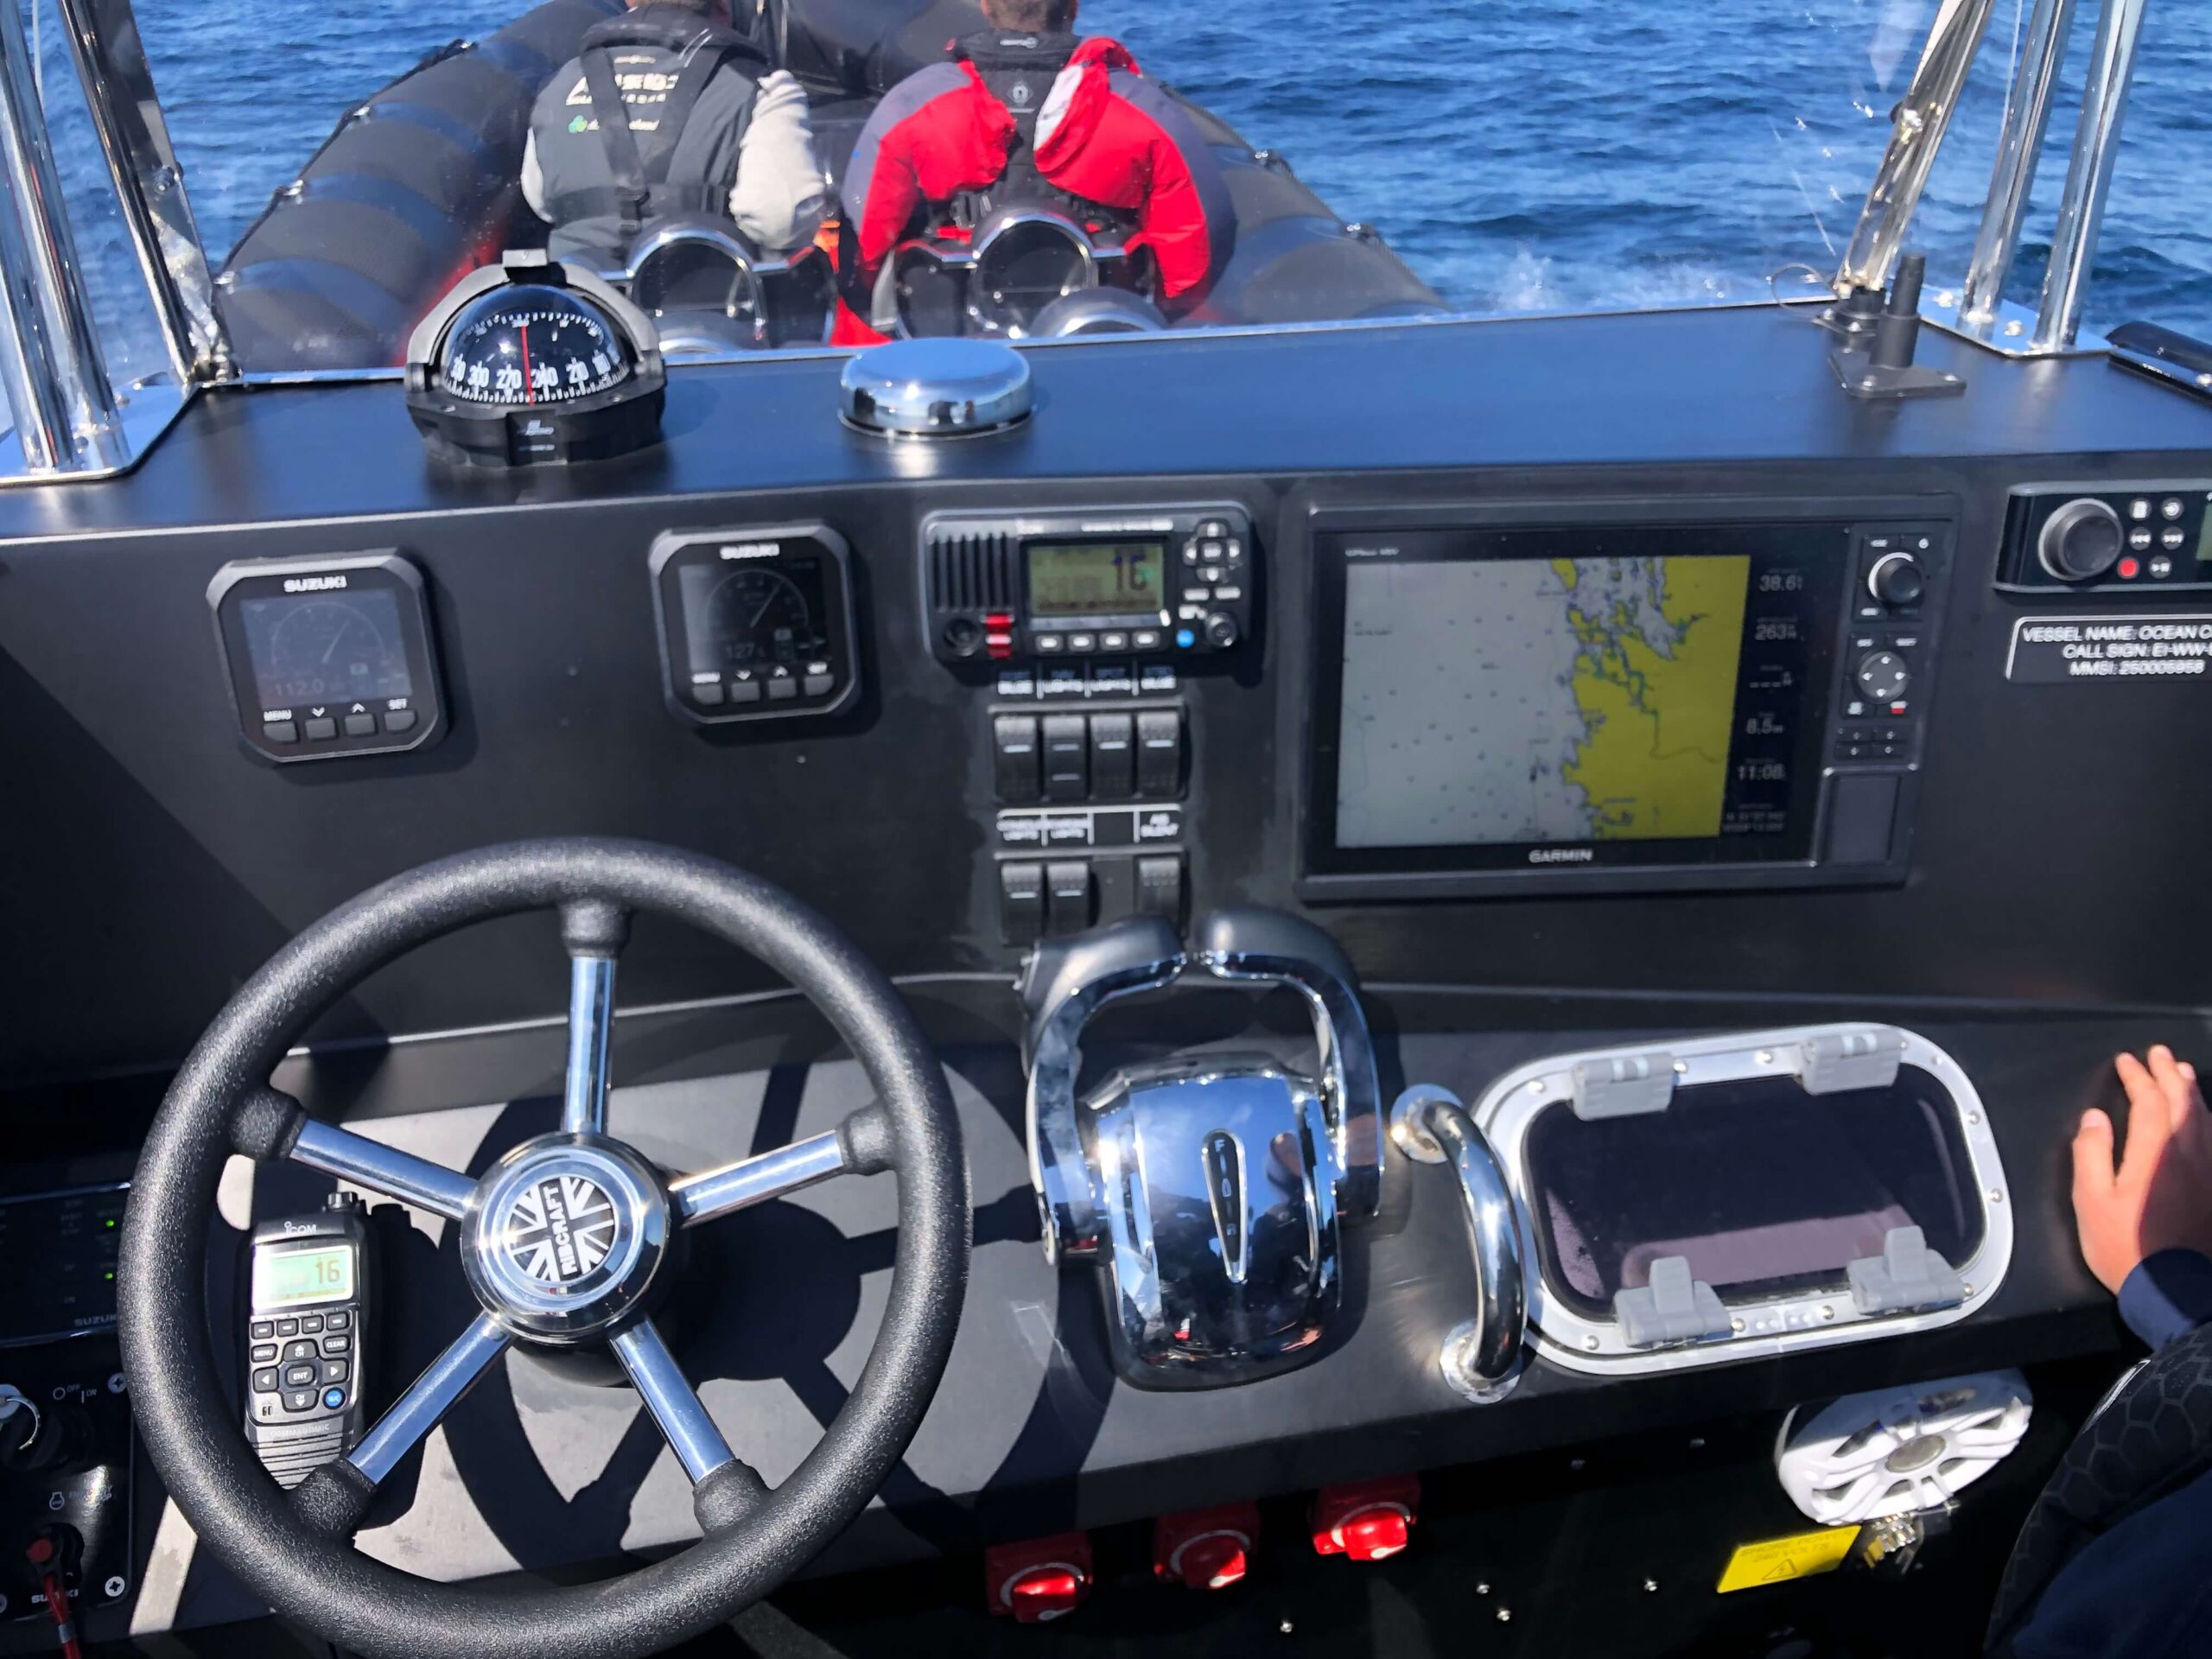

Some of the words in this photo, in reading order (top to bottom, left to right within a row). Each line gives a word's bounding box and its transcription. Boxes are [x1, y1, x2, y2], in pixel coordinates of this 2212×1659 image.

[283, 575, 347, 593] SUZUKI
[2023, 626, 2083, 642] VESSEL
[2139, 625, 2198, 640] OCEAN
[2063, 644, 2104, 658] CALL
[264, 709, 292, 721] MENU
[1529, 849, 1592, 863] GARMIN
[315, 1258, 340, 1285] 16
[74, 1313, 118, 1327] SUZUK
[326, 1339, 346, 1349] CLEAR
[254, 1348, 274, 1357] MENU
[293, 1371, 308, 1381] ENT
[67, 1383, 80, 1393] OFF
[86, 1389, 97, 1397] ON
